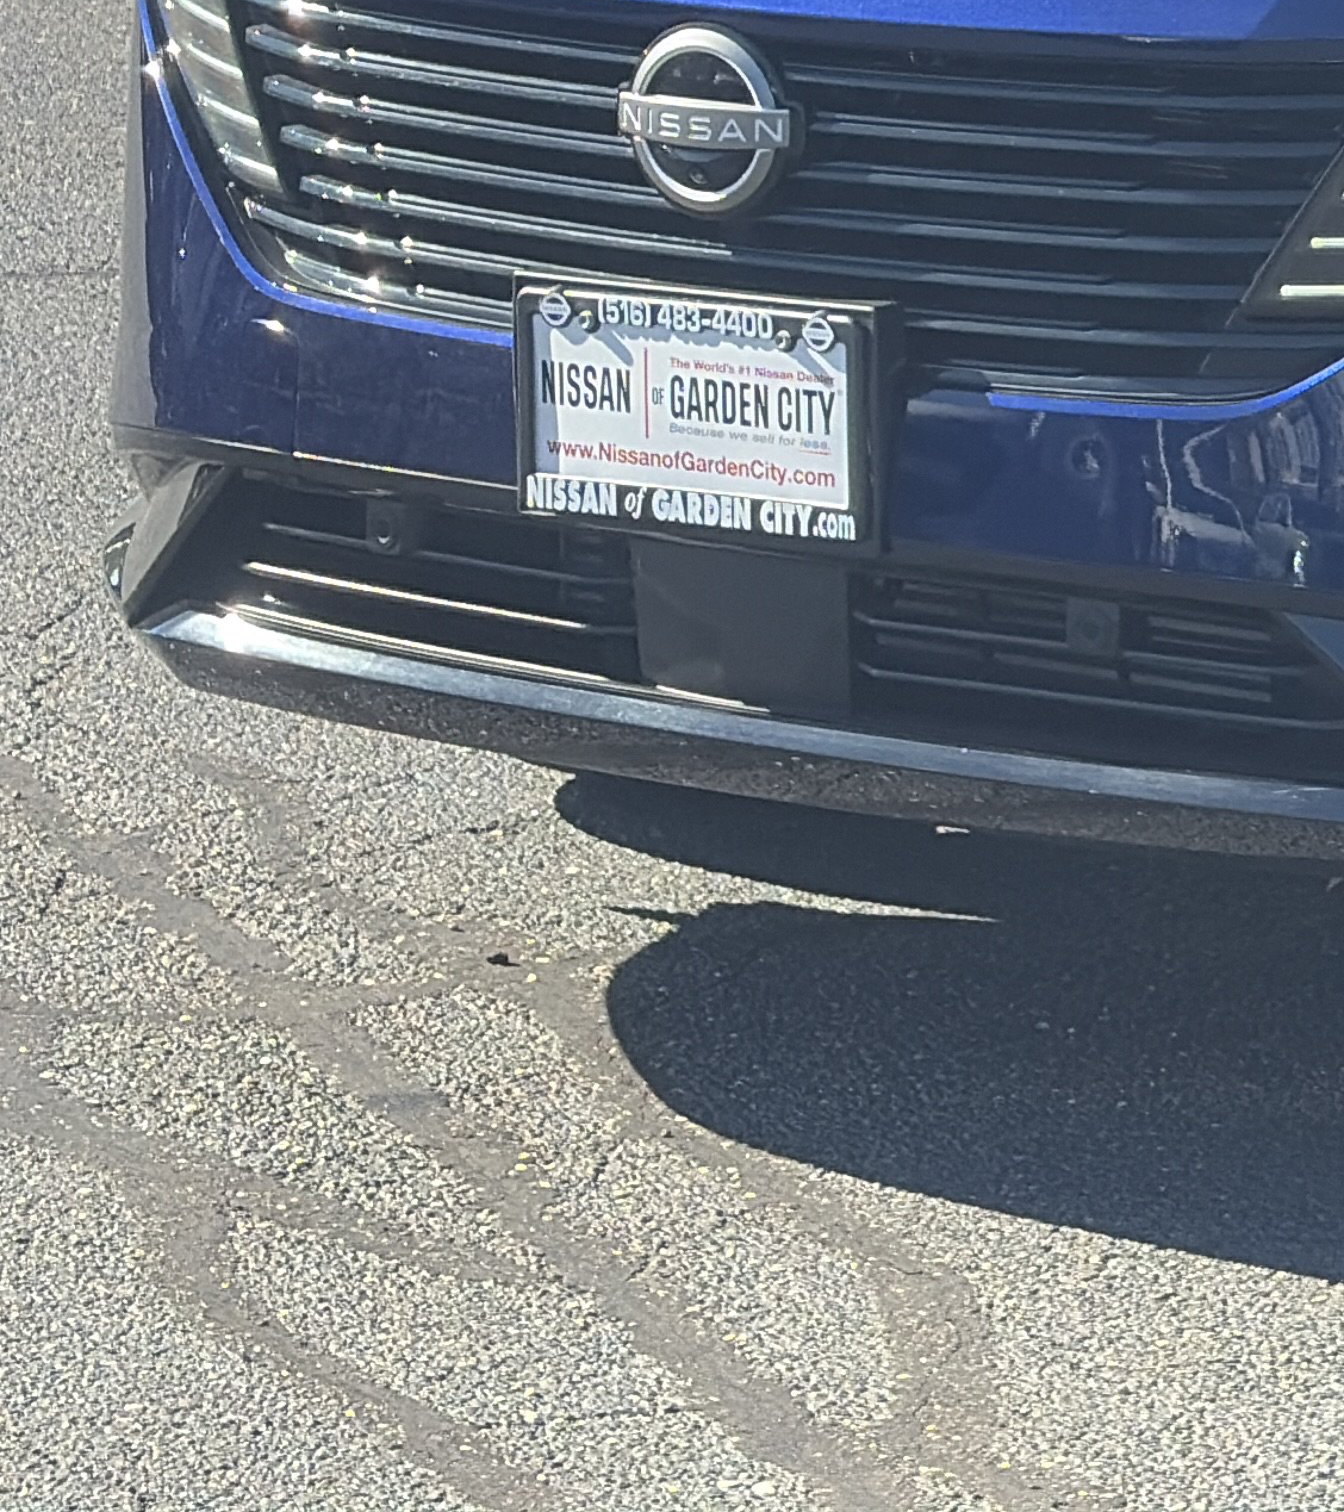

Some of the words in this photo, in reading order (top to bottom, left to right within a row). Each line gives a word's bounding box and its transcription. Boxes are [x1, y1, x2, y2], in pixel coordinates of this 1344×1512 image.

[621, 101, 784, 143] NISSAN
[598, 297, 651, 328] (516)
[656, 302, 774, 338] 483-4400
[670, 356, 690, 369] The
[693, 360, 735, 374] World's
[738, 365, 751, 376] #1
[755, 367, 794, 380] Nissan
[541, 359, 632, 413] NISSAN
[651, 387, 665, 406] OF
[670, 374, 769, 429] GARDEN
[777, 386, 836, 436] CITY
[669, 422, 725, 439] Because
[728, 431, 748, 442] we
[752, 433, 775, 445] sell
[778, 436, 796, 447] for
[547, 438, 836, 487] www.NissanofGardenCity.com
[526, 474, 618, 516] NISSAN
[624, 486, 648, 520] of
[651, 488, 752, 531] GARDEN
[759, 500, 857, 541] CITY.com
